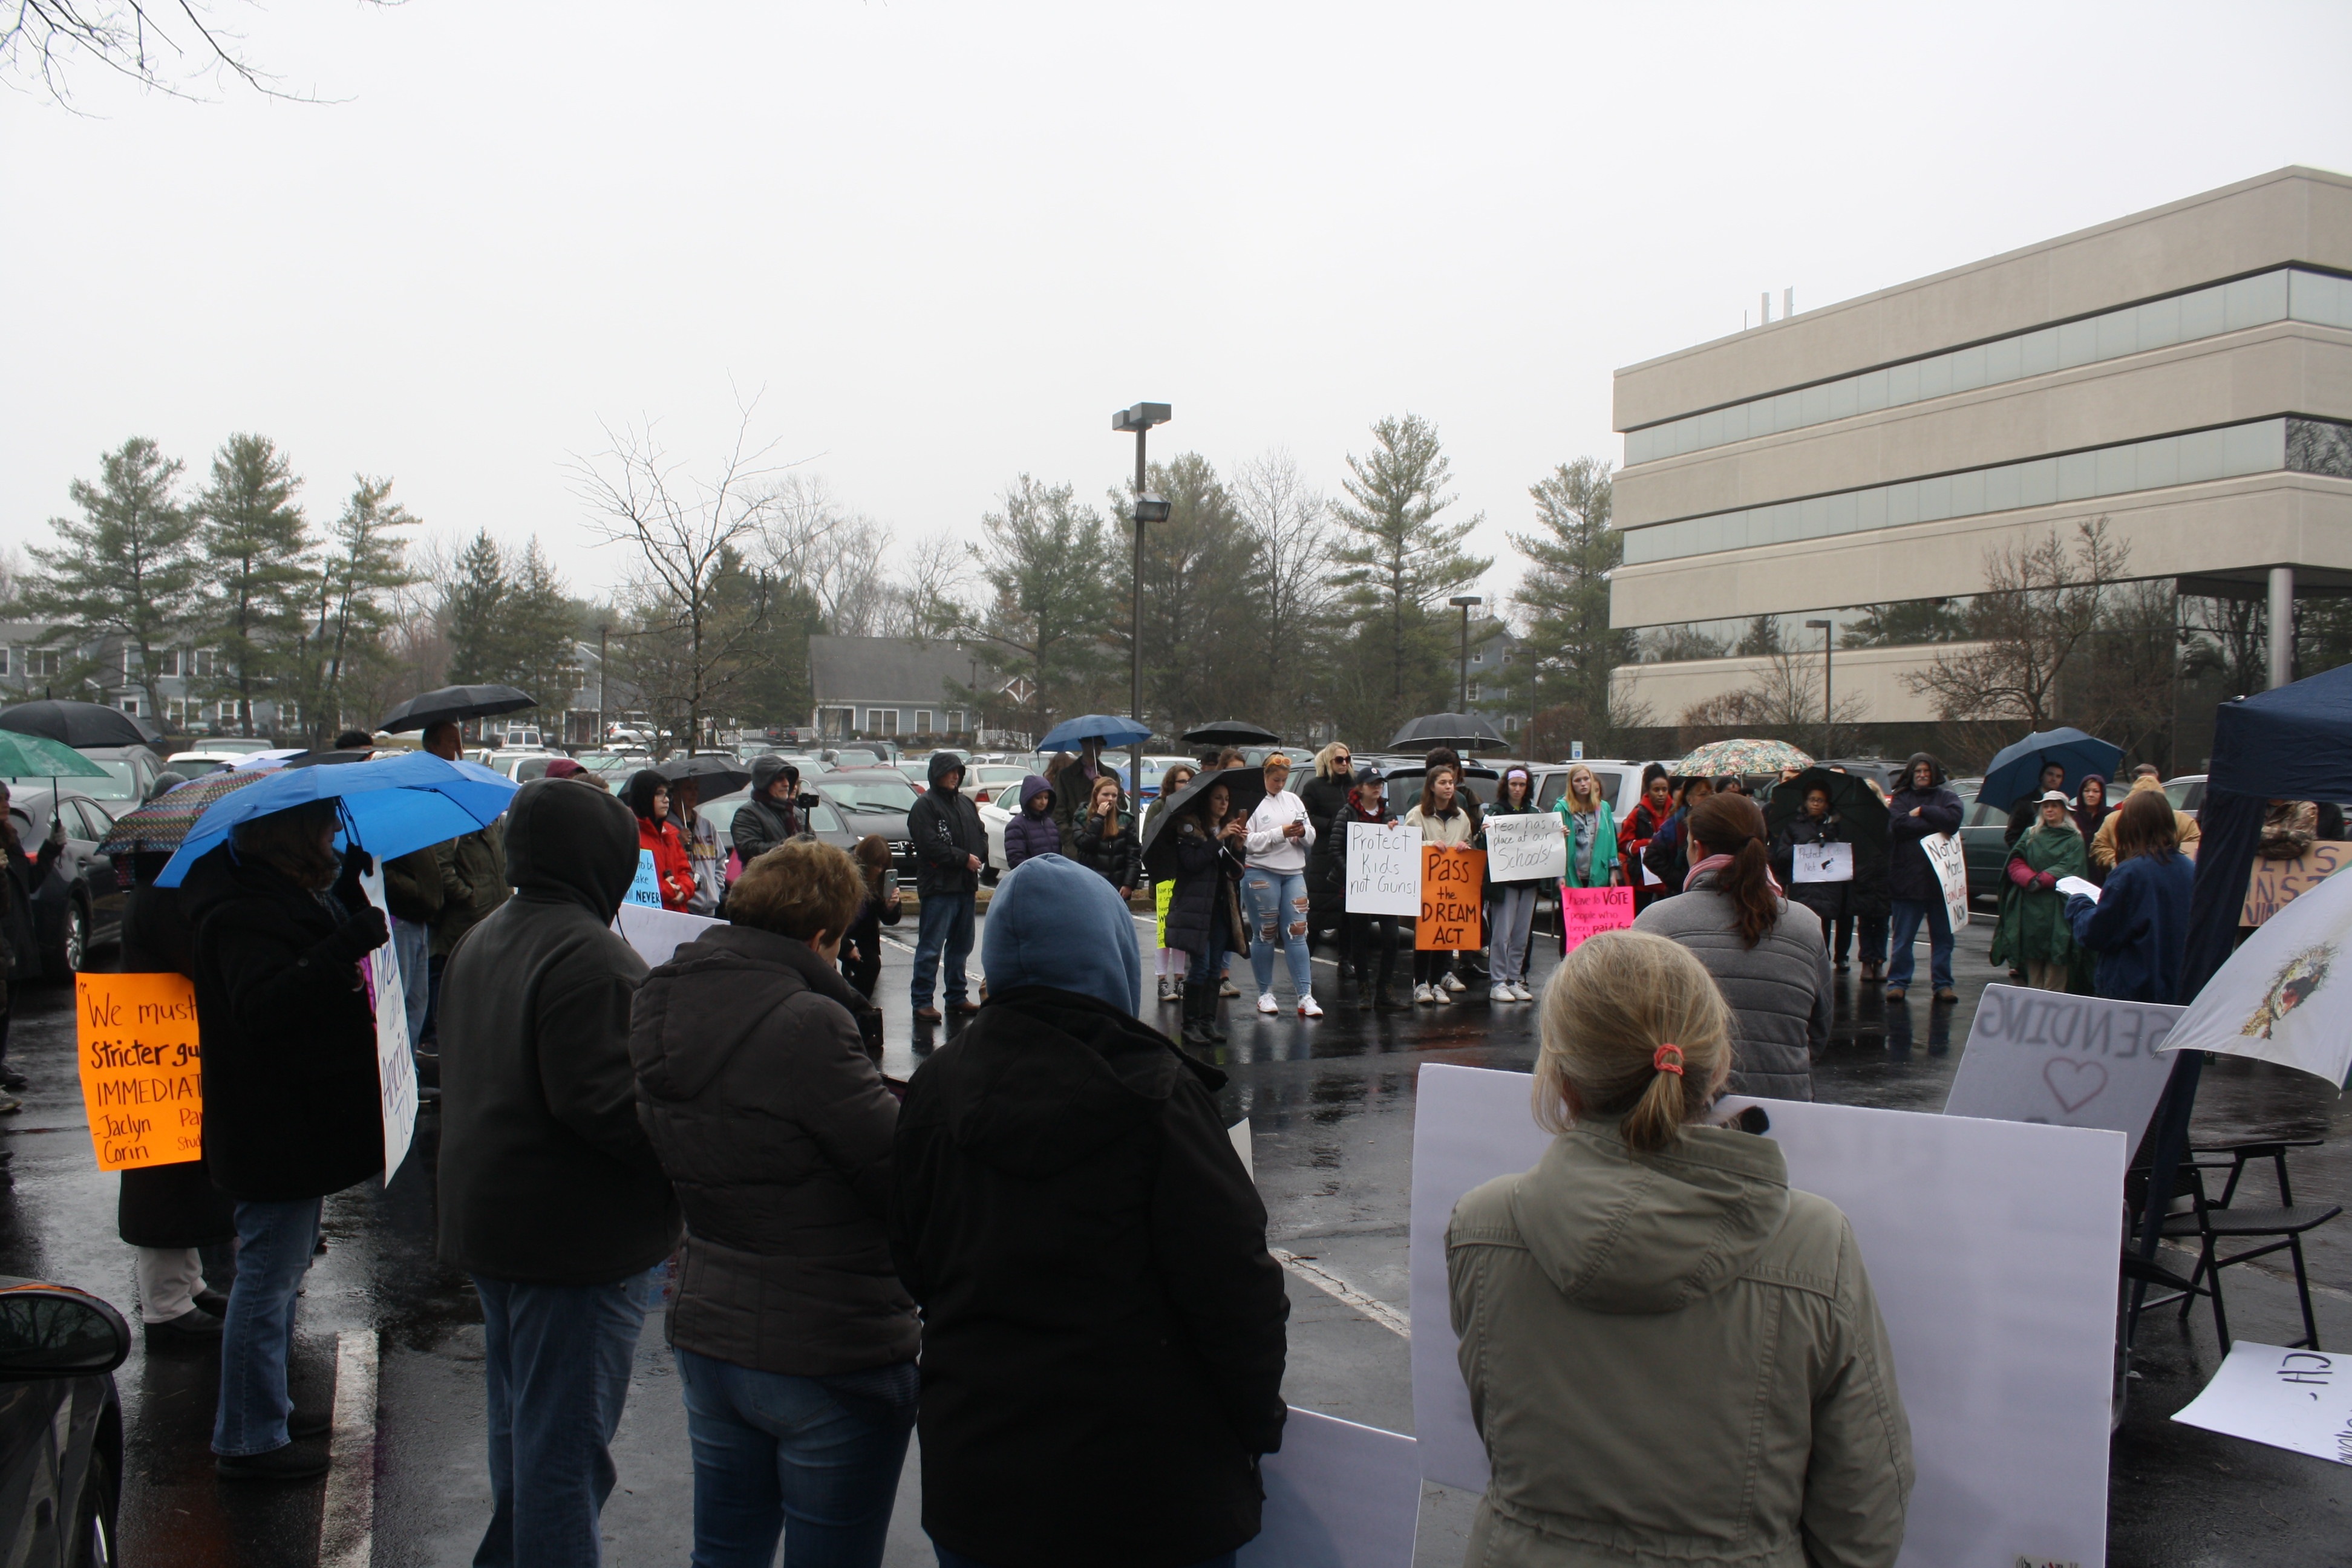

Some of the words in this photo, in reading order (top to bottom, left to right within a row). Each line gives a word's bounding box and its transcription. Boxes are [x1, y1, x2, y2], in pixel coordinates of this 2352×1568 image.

[1494, 818, 1520, 833] Fear
[1525, 817, 1546, 830] has
[1353, 824, 1411, 852] Protect
[1494, 835, 1514, 852] place
[1518, 831, 1527, 843] at
[1533, 832, 1550, 841] our
[1798, 848, 1823, 859] Protect
[1926, 840, 1950, 862] Not
[1362, 853, 1399, 875] Kids
[1428, 853, 1469, 883] Pass
[1351, 874, 1371, 895] not
[1377, 875, 1416, 897] Guns!
[1437, 886, 1457, 900] the
[636, 890, 661, 903] NEVER
[1602, 892, 1628, 905] VOTE
[1422, 903, 1477, 923] DREAM
[1571, 911, 1595, 923] people
[1599, 910, 1618, 919] who
[1432, 926, 1464, 944] ACT
[1593, 923, 1613, 935] paid
[139, 994, 196, 1025] must
[91, 1039, 170, 1069] Stricter
[104, 1140, 149, 1163] Corin
